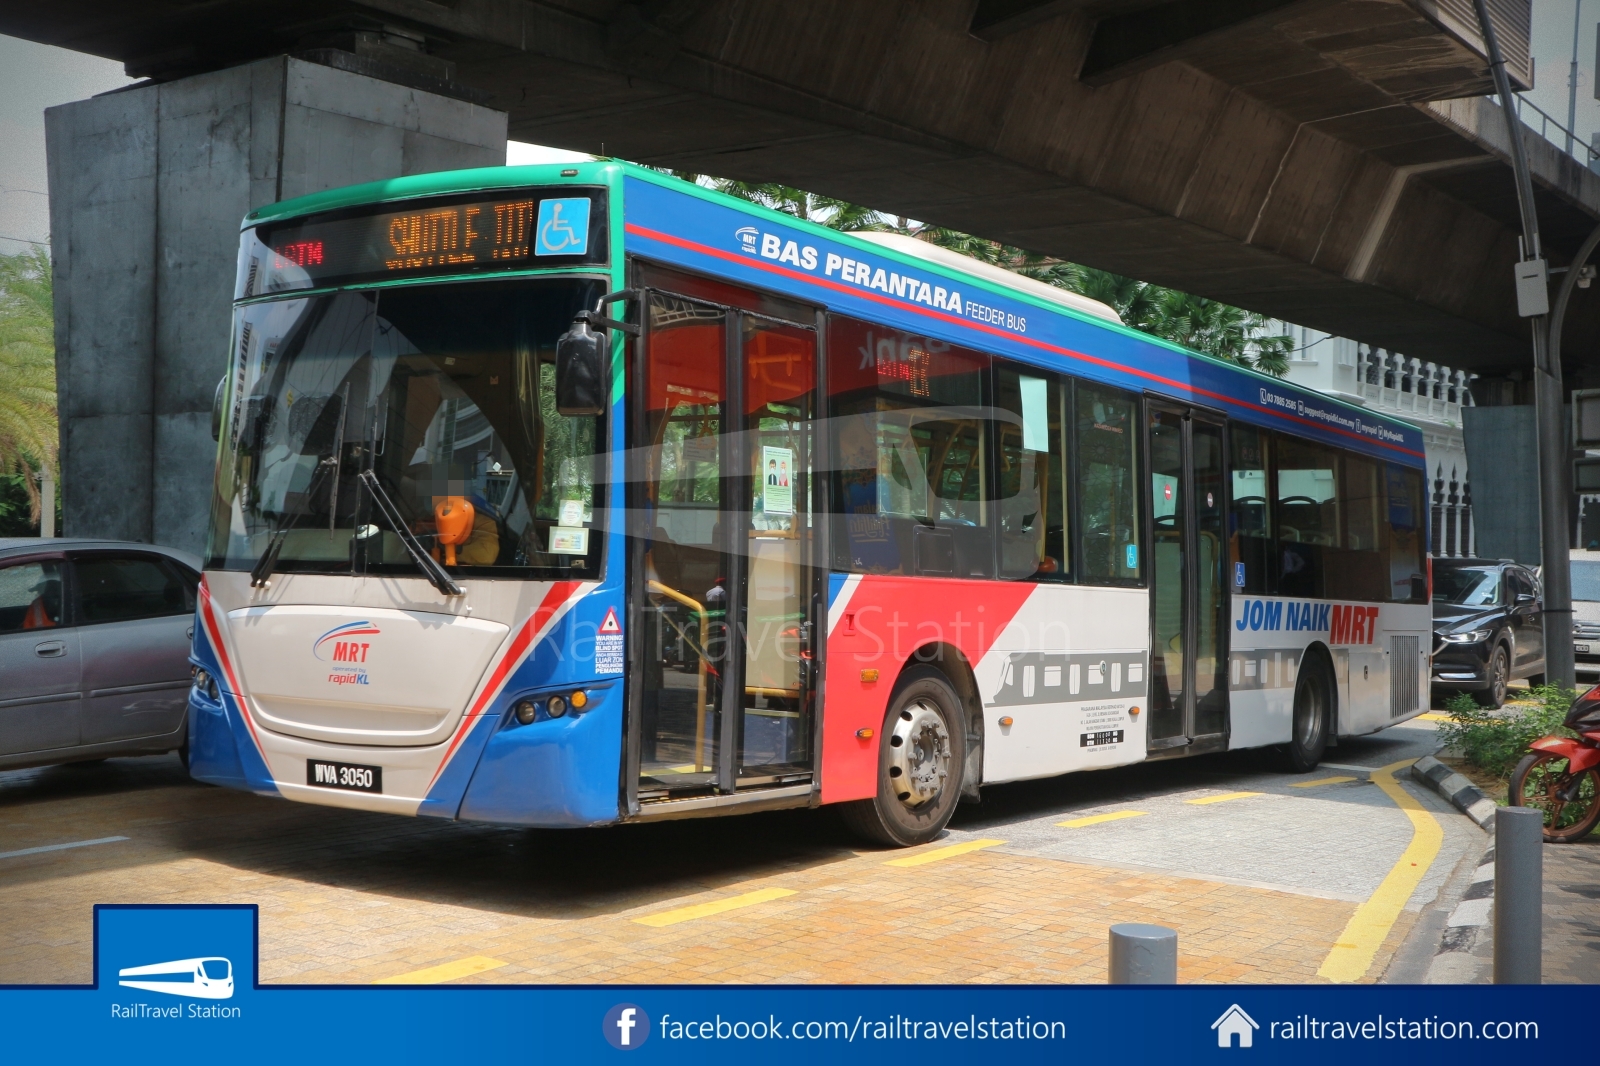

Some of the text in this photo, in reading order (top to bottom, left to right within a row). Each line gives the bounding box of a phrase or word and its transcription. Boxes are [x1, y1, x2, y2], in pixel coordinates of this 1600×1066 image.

[743, 233, 756, 245] MRT
[760, 233, 1026, 333] BAS PERANTARA FEEDER BUS
[1236, 600, 1379, 644] JOM NAIK MRT
[333, 641, 370, 663] MRT
[328, 673, 369, 685] rapidKL
[314, 763, 373, 788] WVA 3050
